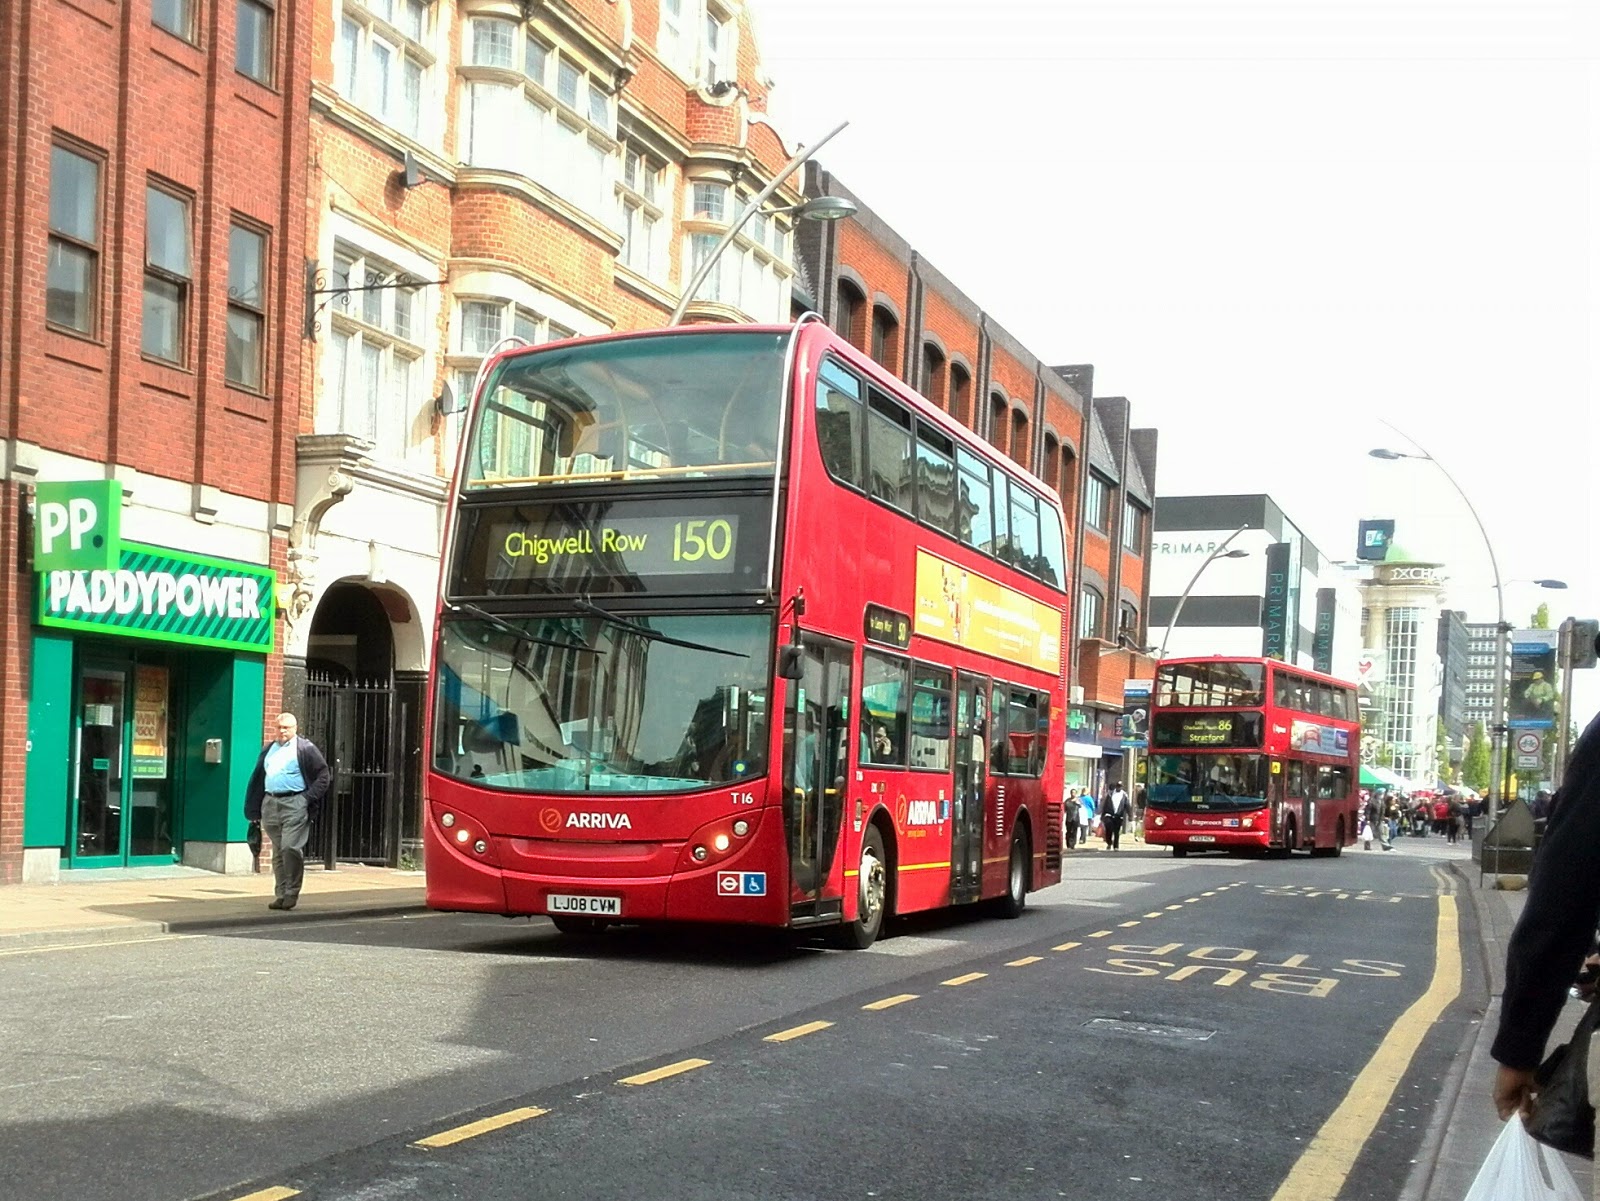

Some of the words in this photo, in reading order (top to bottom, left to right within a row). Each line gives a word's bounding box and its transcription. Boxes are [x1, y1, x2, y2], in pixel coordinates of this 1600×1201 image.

[505, 531, 593, 564] Chigwell
[602, 528, 648, 553] Row
[673, 519, 733, 562] 150
[1267, 573, 1284, 656] PRIMARK
[1317, 612, 1331, 671] PRIMAR
[1189, 733, 1225, 742] Stratford
[1218, 720, 1232, 731] 86
[566, 812, 632, 829] ARRIVA
[553, 896, 587, 912] LJ08
[590, 898, 616, 913] CVM
